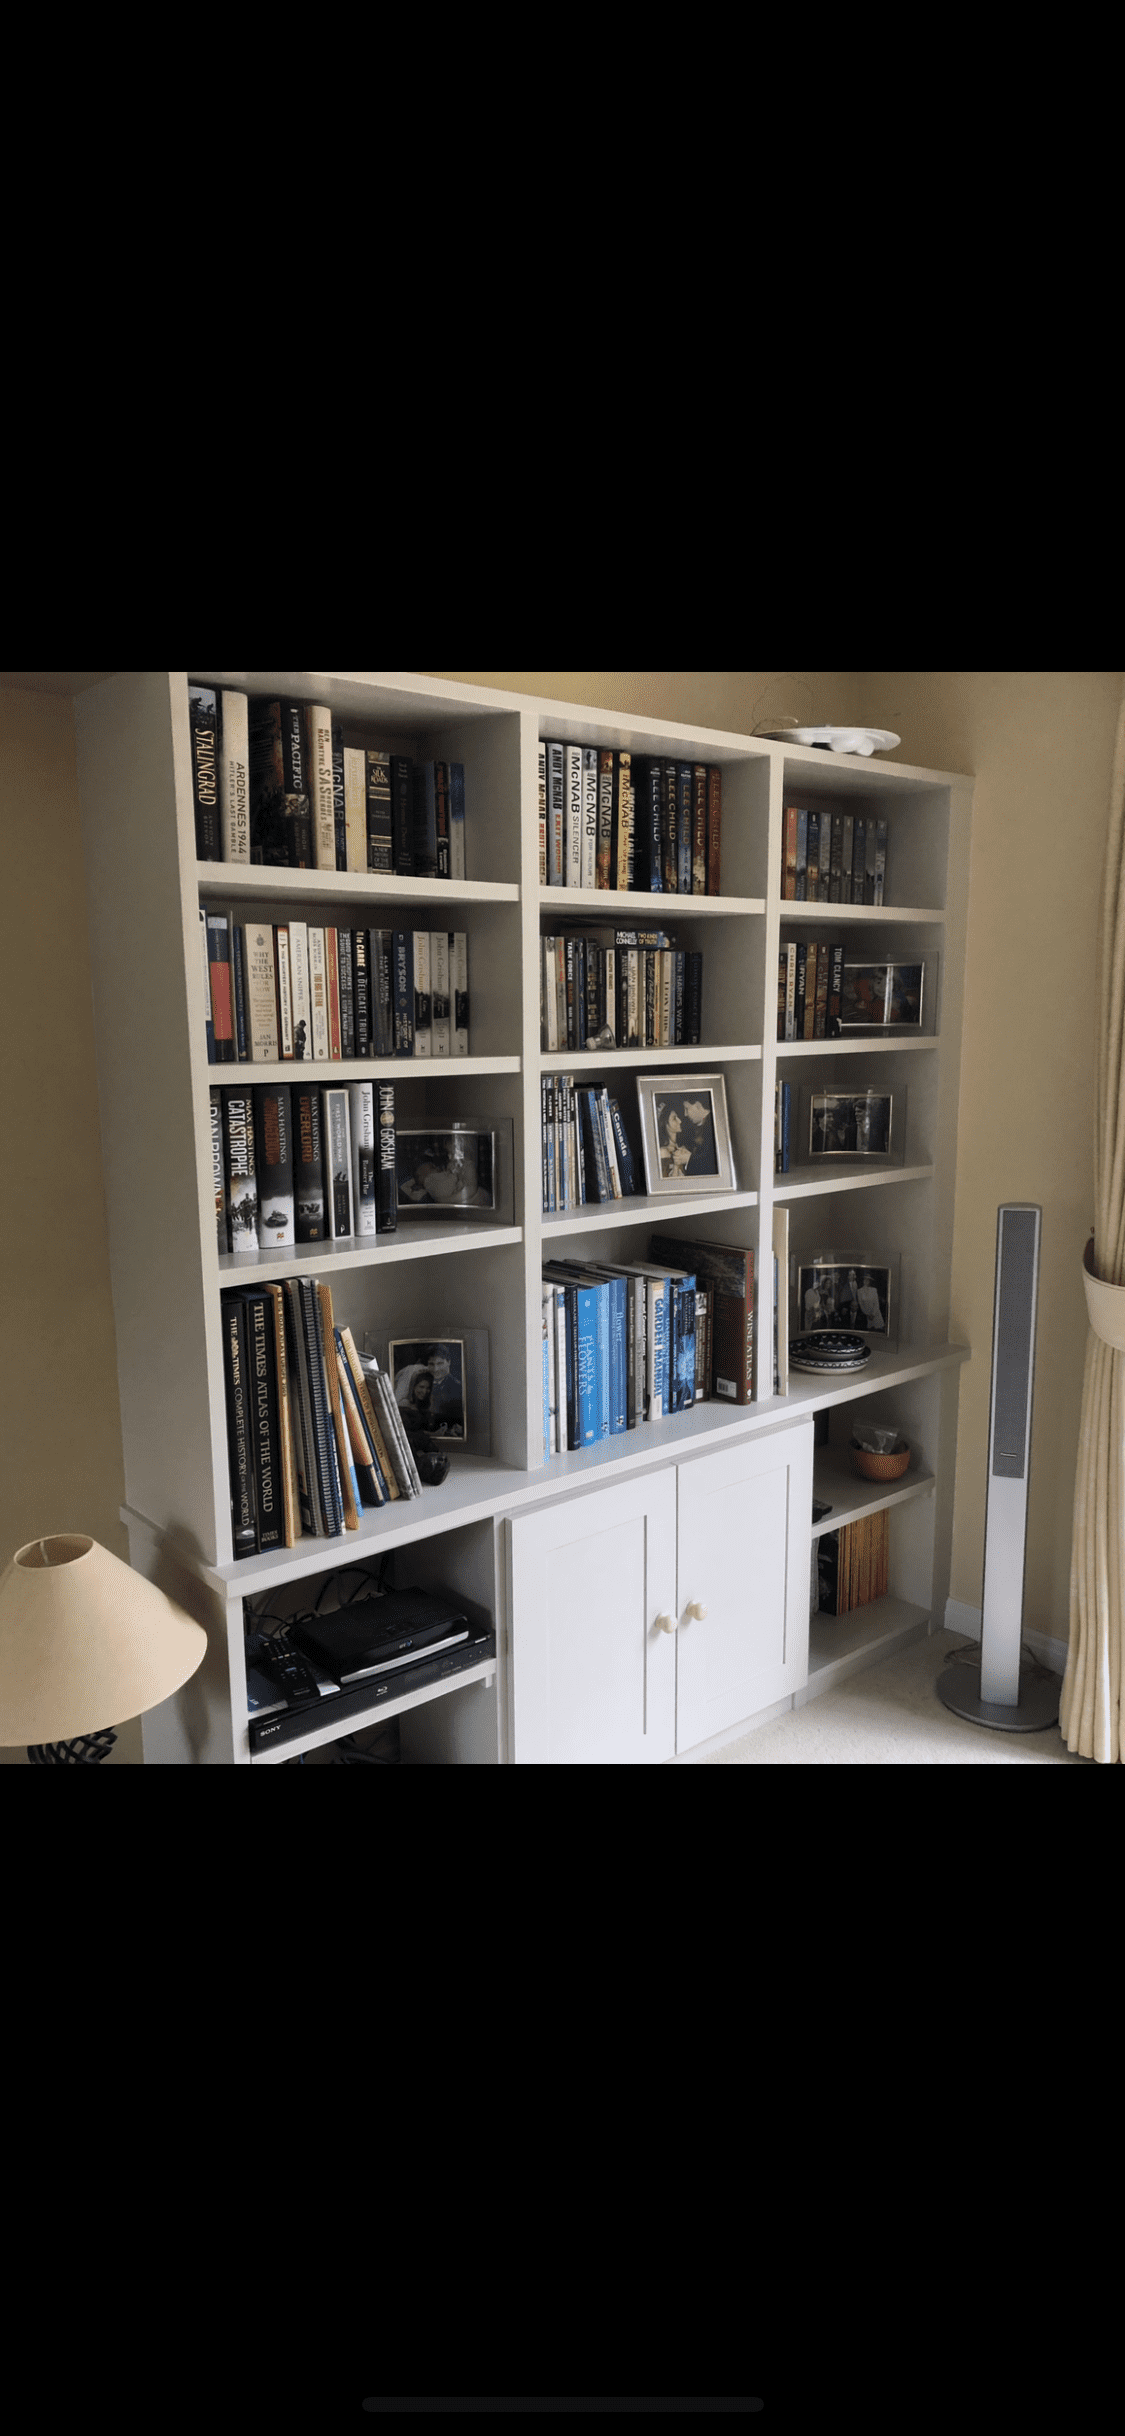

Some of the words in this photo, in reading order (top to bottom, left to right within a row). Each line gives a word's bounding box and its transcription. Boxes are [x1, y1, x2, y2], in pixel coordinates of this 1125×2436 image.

[194, 728, 217, 805] STALINGRAD
[291, 734, 302, 789] PACIFIC
[552, 749, 562, 774] ANDY
[236, 762, 246, 827] ARDENNES
[319, 768, 331, 795] SAS
[333, 758, 344, 820] McNAB
[553, 777, 562, 810] McNAB
[571, 756, 580, 813] McNAB
[652, 780, 660, 801] LEE
[586, 778, 596, 836] McNAB
[601, 781, 611, 838] McNAB
[621, 778, 629, 828] McNAB
[238, 830, 247, 854] 1944
[572, 816, 580, 864] SILENCER
[653, 805, 661, 842] CHILD
[295, 938, 303, 975] AMERICAN
[417, 936, 425, 955] John
[436, 937, 444, 956] John
[456, 938, 464, 957] John
[834, 948, 842, 962] TOM
[398, 946, 406, 992] BRYSON
[677, 962, 682, 972] IN
[833, 964, 841, 992] CLANCY
[357, 978, 367, 1013] DELICATE
[359, 1018, 367, 1043] TRUTH
[403, 1040, 408, 1048] OF
[361, 1091, 371, 1111] John
[379, 1086, 394, 1111] JOHN
[228, 1100, 248, 1176] CATASTROPHE
[279, 1120, 287, 1164] HASTINGS
[299, 1097, 313, 1163] OVERLORD
[312, 1119, 320, 1161] HASTINGS
[363, 1114, 373, 1150] Grisham
[614, 1113, 627, 1157] Canada
[247, 1126, 255, 1176] HASTINGS
[381, 1128, 395, 1170] GRISHAM
[230, 1317, 238, 1336] THE
[253, 1302, 265, 1332] THE
[616, 1312, 624, 1342] flower
[655, 1298, 663, 1345] GARDEN
[232, 1359, 240, 1386] TIMES
[254, 1333, 267, 1377] TIMES
[578, 1337, 587, 1395] FLOWERS
[654, 1349, 663, 1398] MANUAL
[234, 1387, 245, 1436] COMPLETE
[257, 1381, 269, 1418] ATLAS
[259, 1420, 270, 1438] OF
[237, 1438, 248, 1475] HISTORY
[260, 1439, 271, 1465] THE
[262, 1468, 273, 1512] WORLD
[240, 1493, 250, 1526] WORLD
[260, 1724, 281, 1737] SONY
